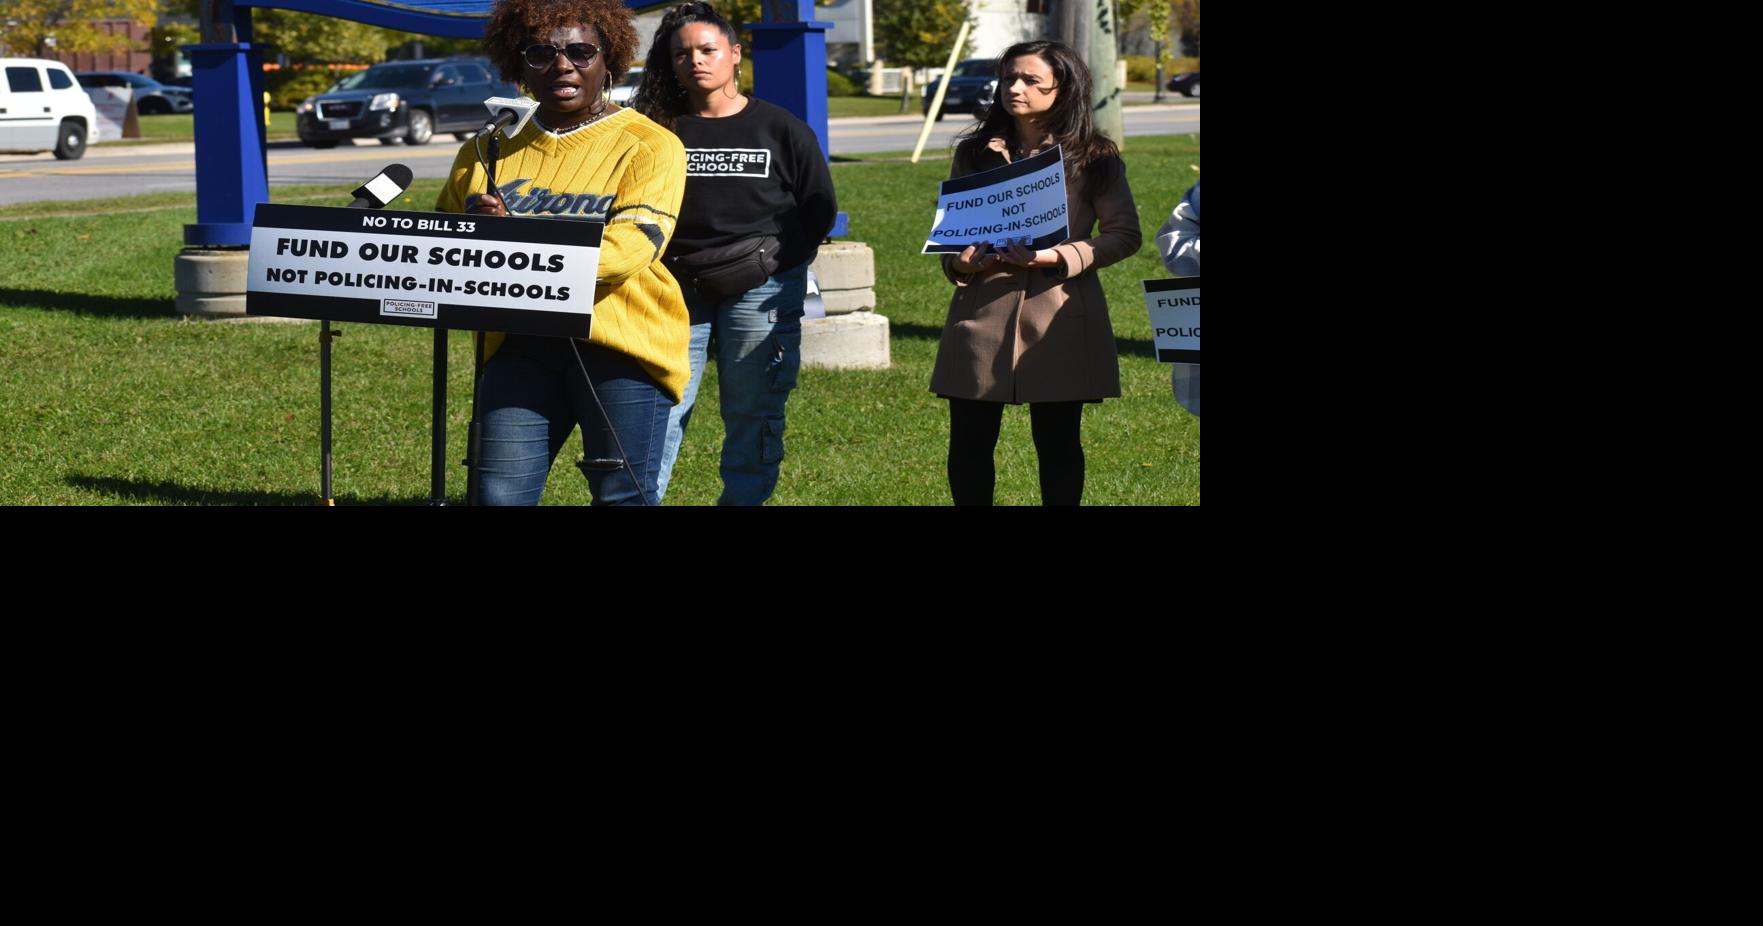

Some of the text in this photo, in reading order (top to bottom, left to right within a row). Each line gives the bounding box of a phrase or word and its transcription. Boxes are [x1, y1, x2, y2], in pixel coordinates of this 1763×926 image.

[687, 153, 765, 163] ICING-FREE
[687, 162, 744, 172] CHOOLS
[946, 172, 1060, 212] FUND OUR SCHOOLS
[1002, 202, 1026, 217] NOT
[362, 216, 476, 233] NO TO BILL 33
[932, 203, 1066, 238] POLICING-IN-SCHOOLS
[276, 238, 565, 273] FUND OUR SCHOOLS
[266, 267, 570, 301] NOT POLICING-IN-SCHOOLS
[386, 301, 433, 309] POLICING-FREE
[1157, 296, 1200, 308] FUND
